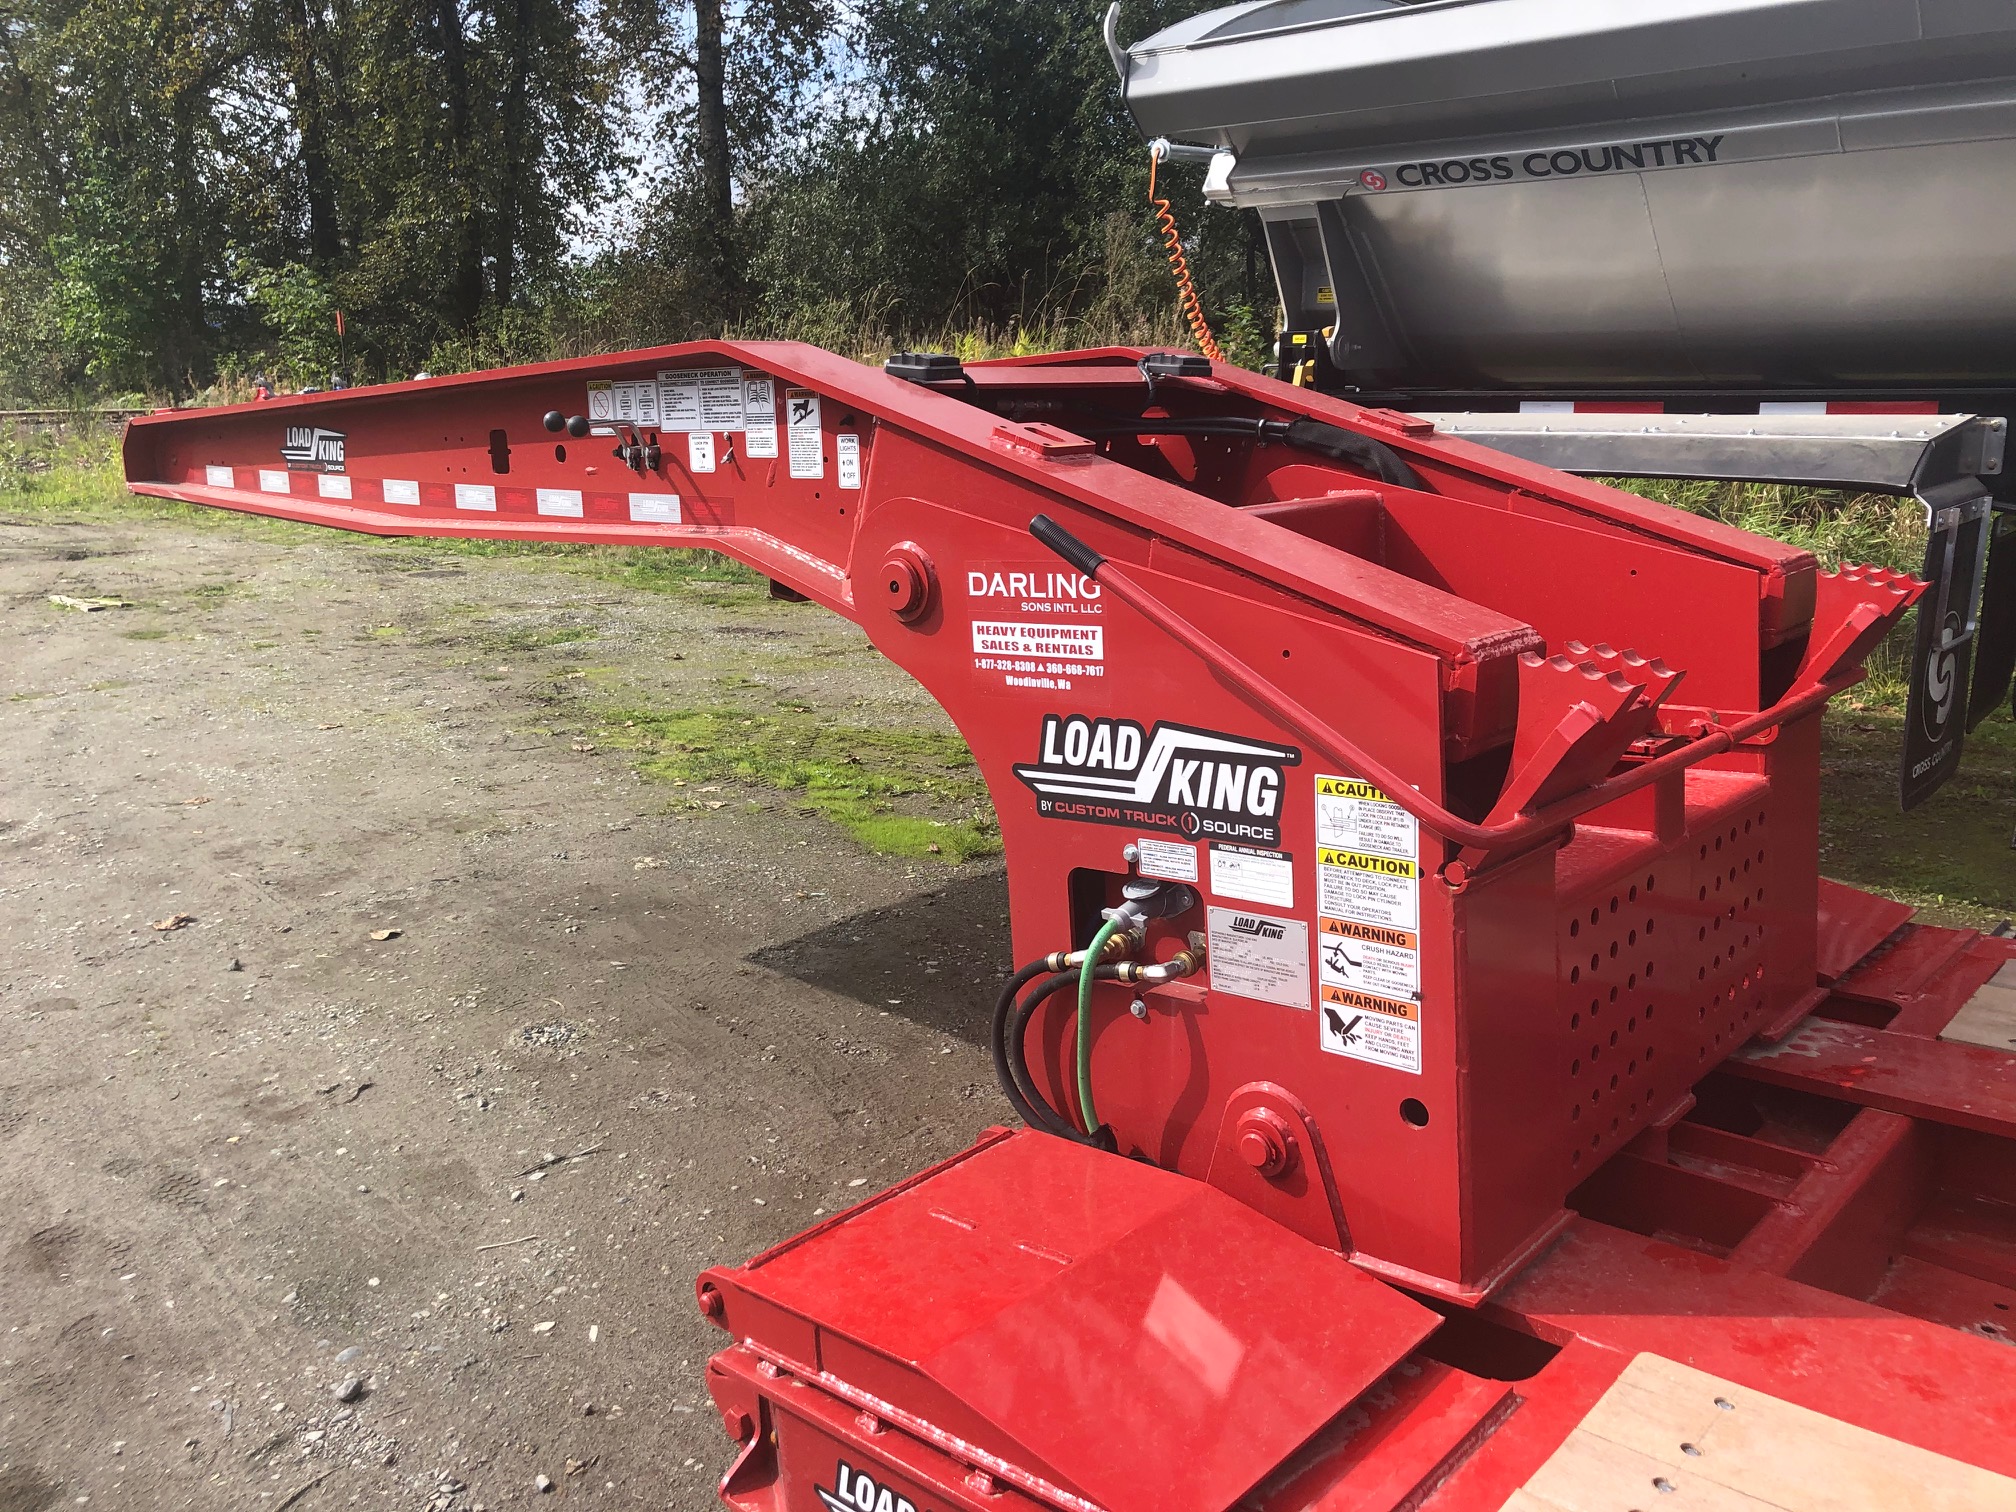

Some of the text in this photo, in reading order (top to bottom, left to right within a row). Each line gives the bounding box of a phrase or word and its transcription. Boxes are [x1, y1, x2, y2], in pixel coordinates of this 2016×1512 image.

[1396, 135, 1725, 187] CROSS COUNTRY
[665, 370, 732, 380] GOOSENECK OPERATION
[286, 427, 312, 447] LOAD
[319, 440, 344, 461] KING
[968, 572, 1101, 600] DARLING
[1021, 602, 1102, 614] SONS INTL LLC
[976, 625, 1098, 640] HEAVY EQUIPMENT
[981, 640, 1094, 656] SALES & RENTALS
[1043, 720, 1142, 771] LOAD
[1168, 758, 1279, 817] KING
[1335, 782, 1393, 800] CAUTI
[1041, 800, 1052, 812] BY
[1054, 802, 1120, 819] CUSTOM
[1124, 810, 1178, 826] TRUCK
[1203, 819, 1274, 840] SOURCE
[1218, 844, 1283, 859] FEDERAL ANNUAL INSPECTION
[1336, 852, 1410, 876] CAUTION
[1324, 872, 1354, 880] GOOSENECK
[1344, 870, 1374, 879] ATTEMPTING
[1382, 874, 1406, 884] CONNECT
[1377, 898, 1402, 906] CYLINDER
[1380, 892, 1396, 900] CAUSE
[1362, 906, 1392, 916] OPERATORS
[1234, 916, 1256, 929] LOAD
[1262, 927, 1284, 940] KING
[1340, 922, 1406, 946] WARNING
[1362, 944, 1414, 960] CRUSH HAZARD
[1342, 992, 1408, 1016] WARNING
[1364, 1015, 1385, 1024] MOVING
[1364, 1021, 1404, 1034] CAUSE SEVERE
[1376, 1042, 1400, 1052] CLOTHING
[1380, 1048, 1398, 1058] MOVING
